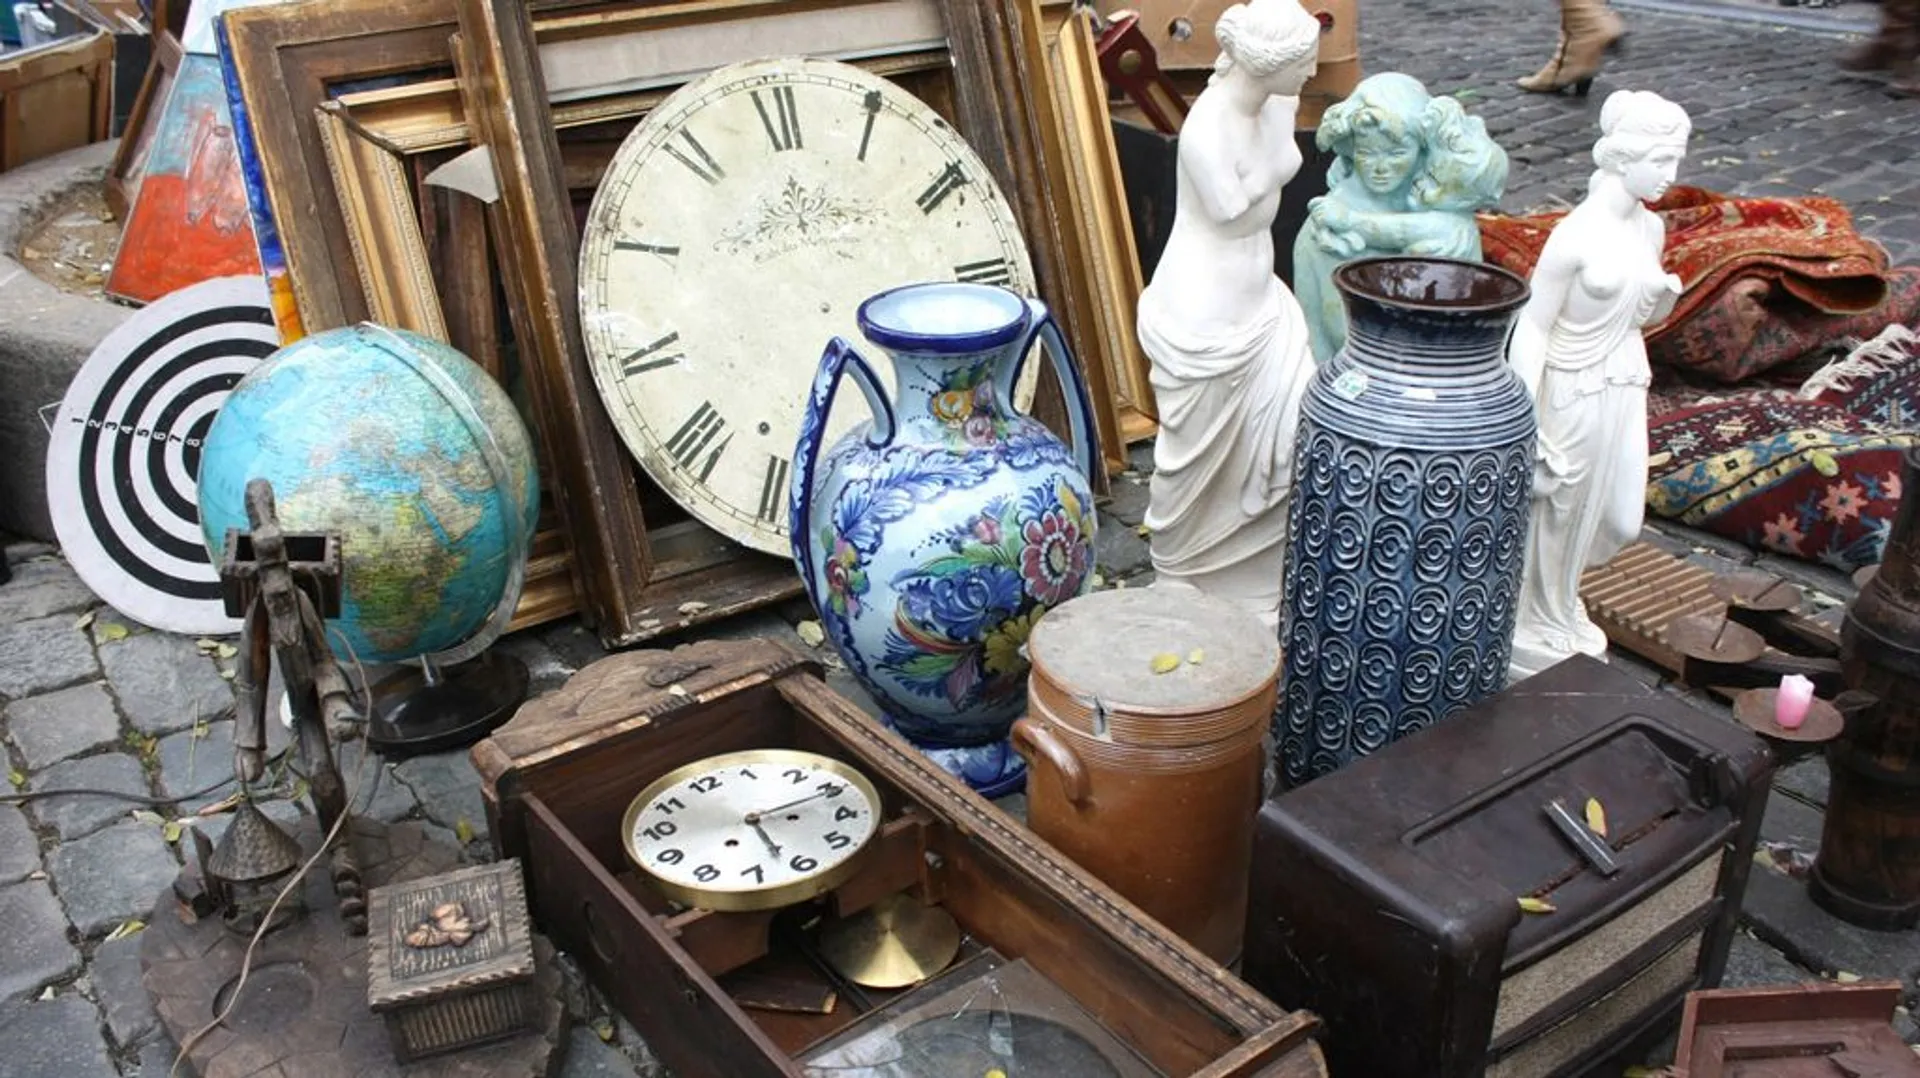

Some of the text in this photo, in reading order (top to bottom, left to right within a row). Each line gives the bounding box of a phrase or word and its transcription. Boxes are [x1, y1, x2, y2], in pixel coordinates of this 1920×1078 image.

[105, 421, 118, 431] 3
[120, 424, 133, 434] 4
[137, 428, 149, 438] 5
[169, 434, 182, 444] 7
[739, 768, 758, 780] 1
[782, 768, 809, 785] 2
[688, 775, 723, 794] 12
[655, 797, 686, 815] 11
[834, 805, 857, 822] 4
[643, 820, 678, 841] 10
[823, 830, 852, 850] 5
[656, 848, 685, 866] 9
[789, 854, 818, 873] 6
[692, 863, 721, 883] 8
[740, 864, 764, 885] 7
